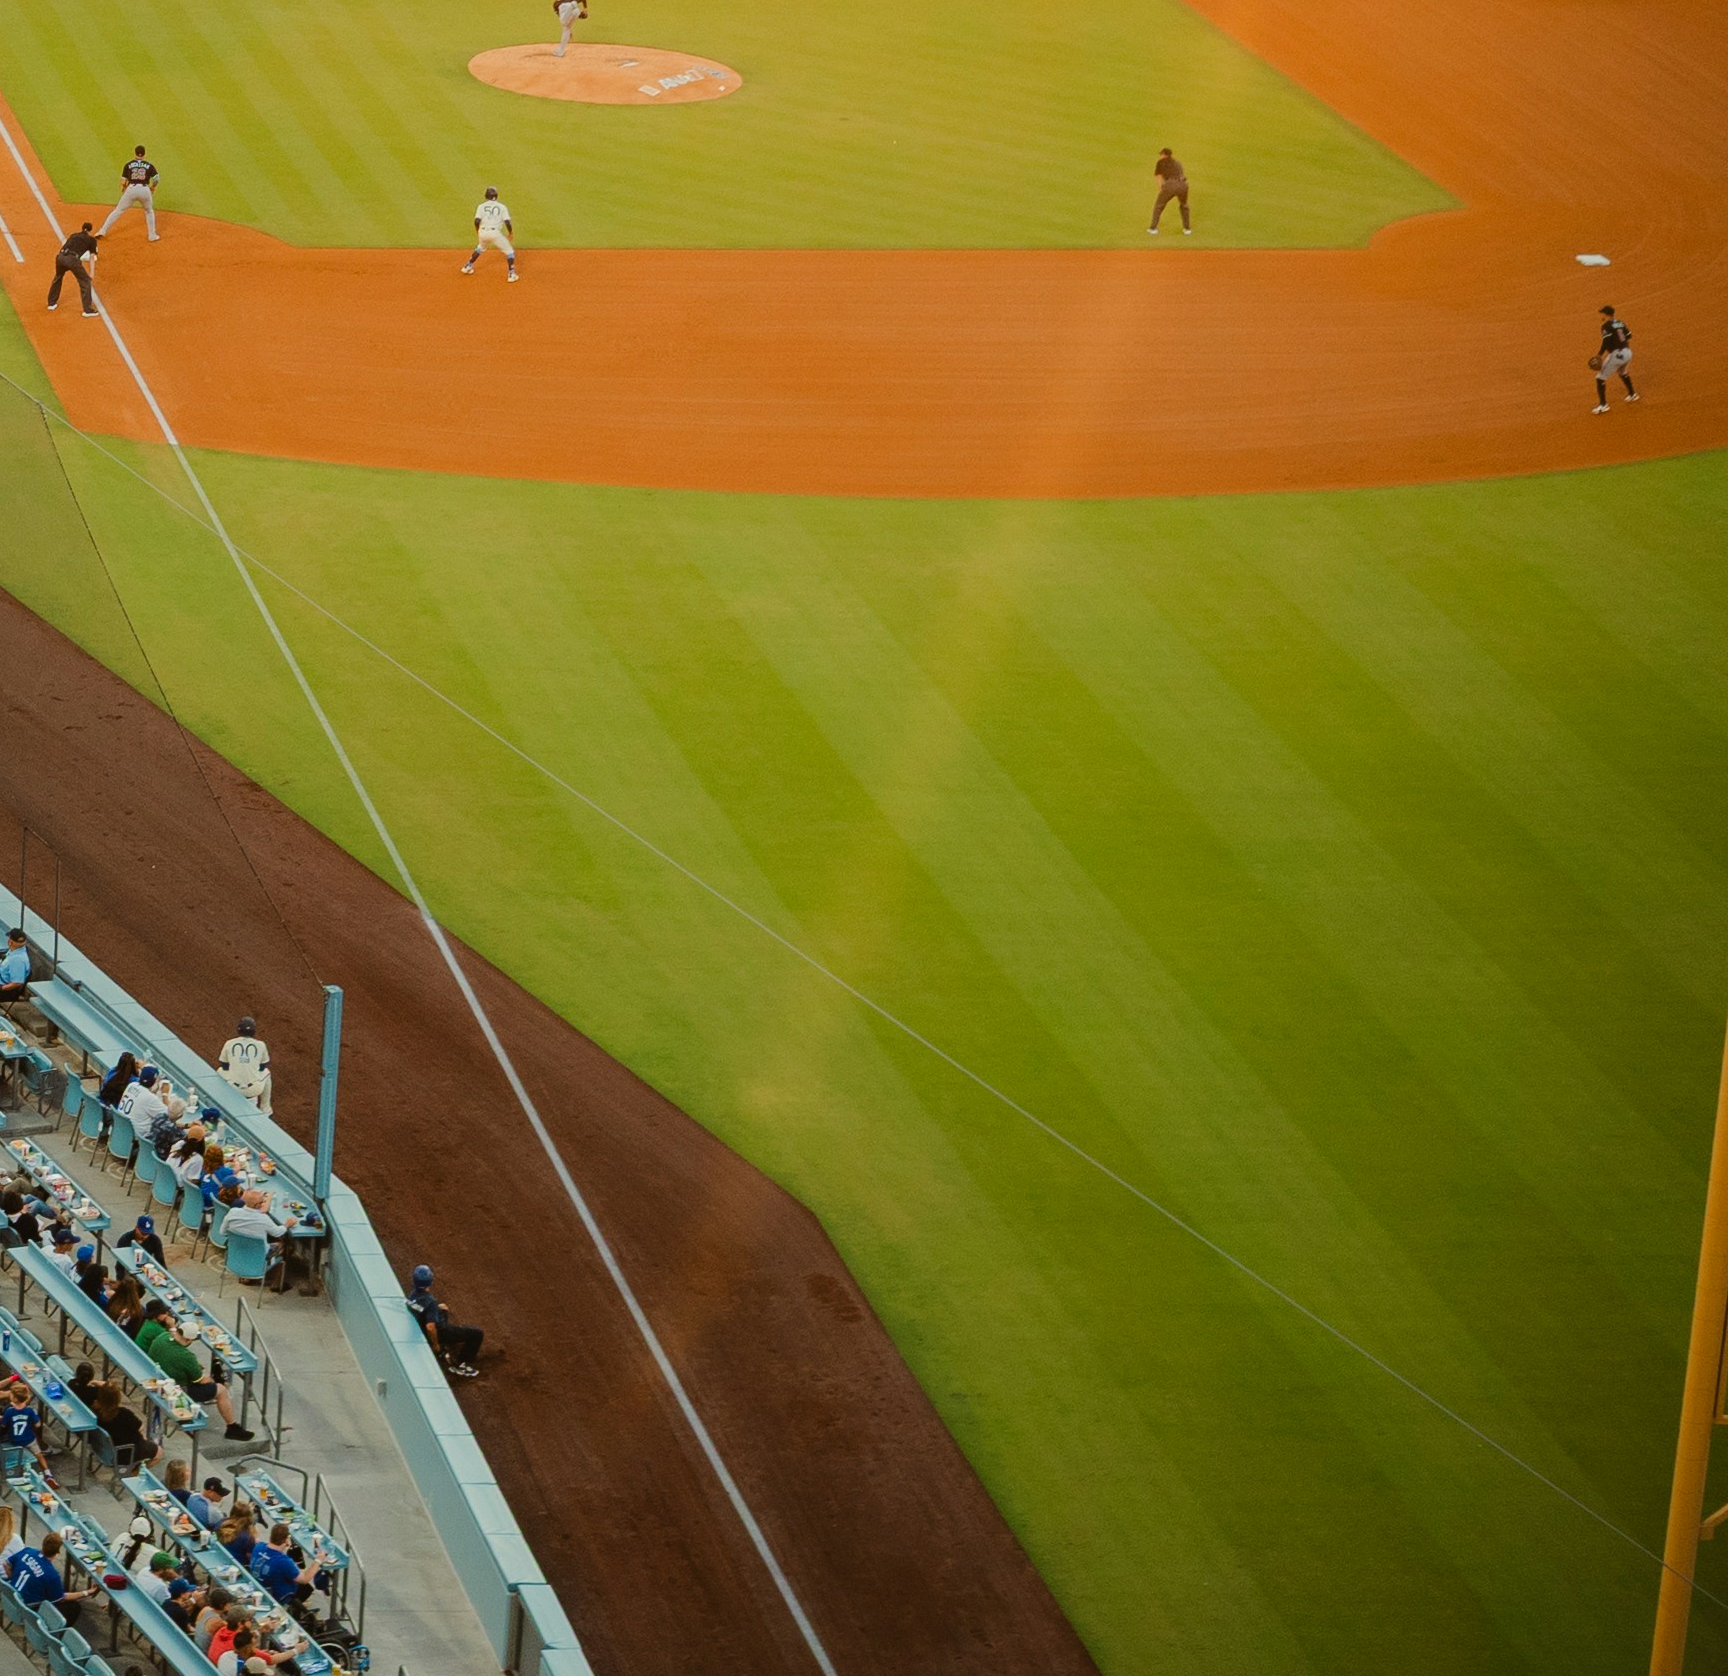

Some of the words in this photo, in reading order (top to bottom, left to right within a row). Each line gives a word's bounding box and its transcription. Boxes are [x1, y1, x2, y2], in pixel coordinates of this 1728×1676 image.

[483, 206, 500, 216] 50
[119, 1096, 133, 1115] 50
[13, 1421, 27, 1436] 17
[15, 1569, 30, 1591] 11
